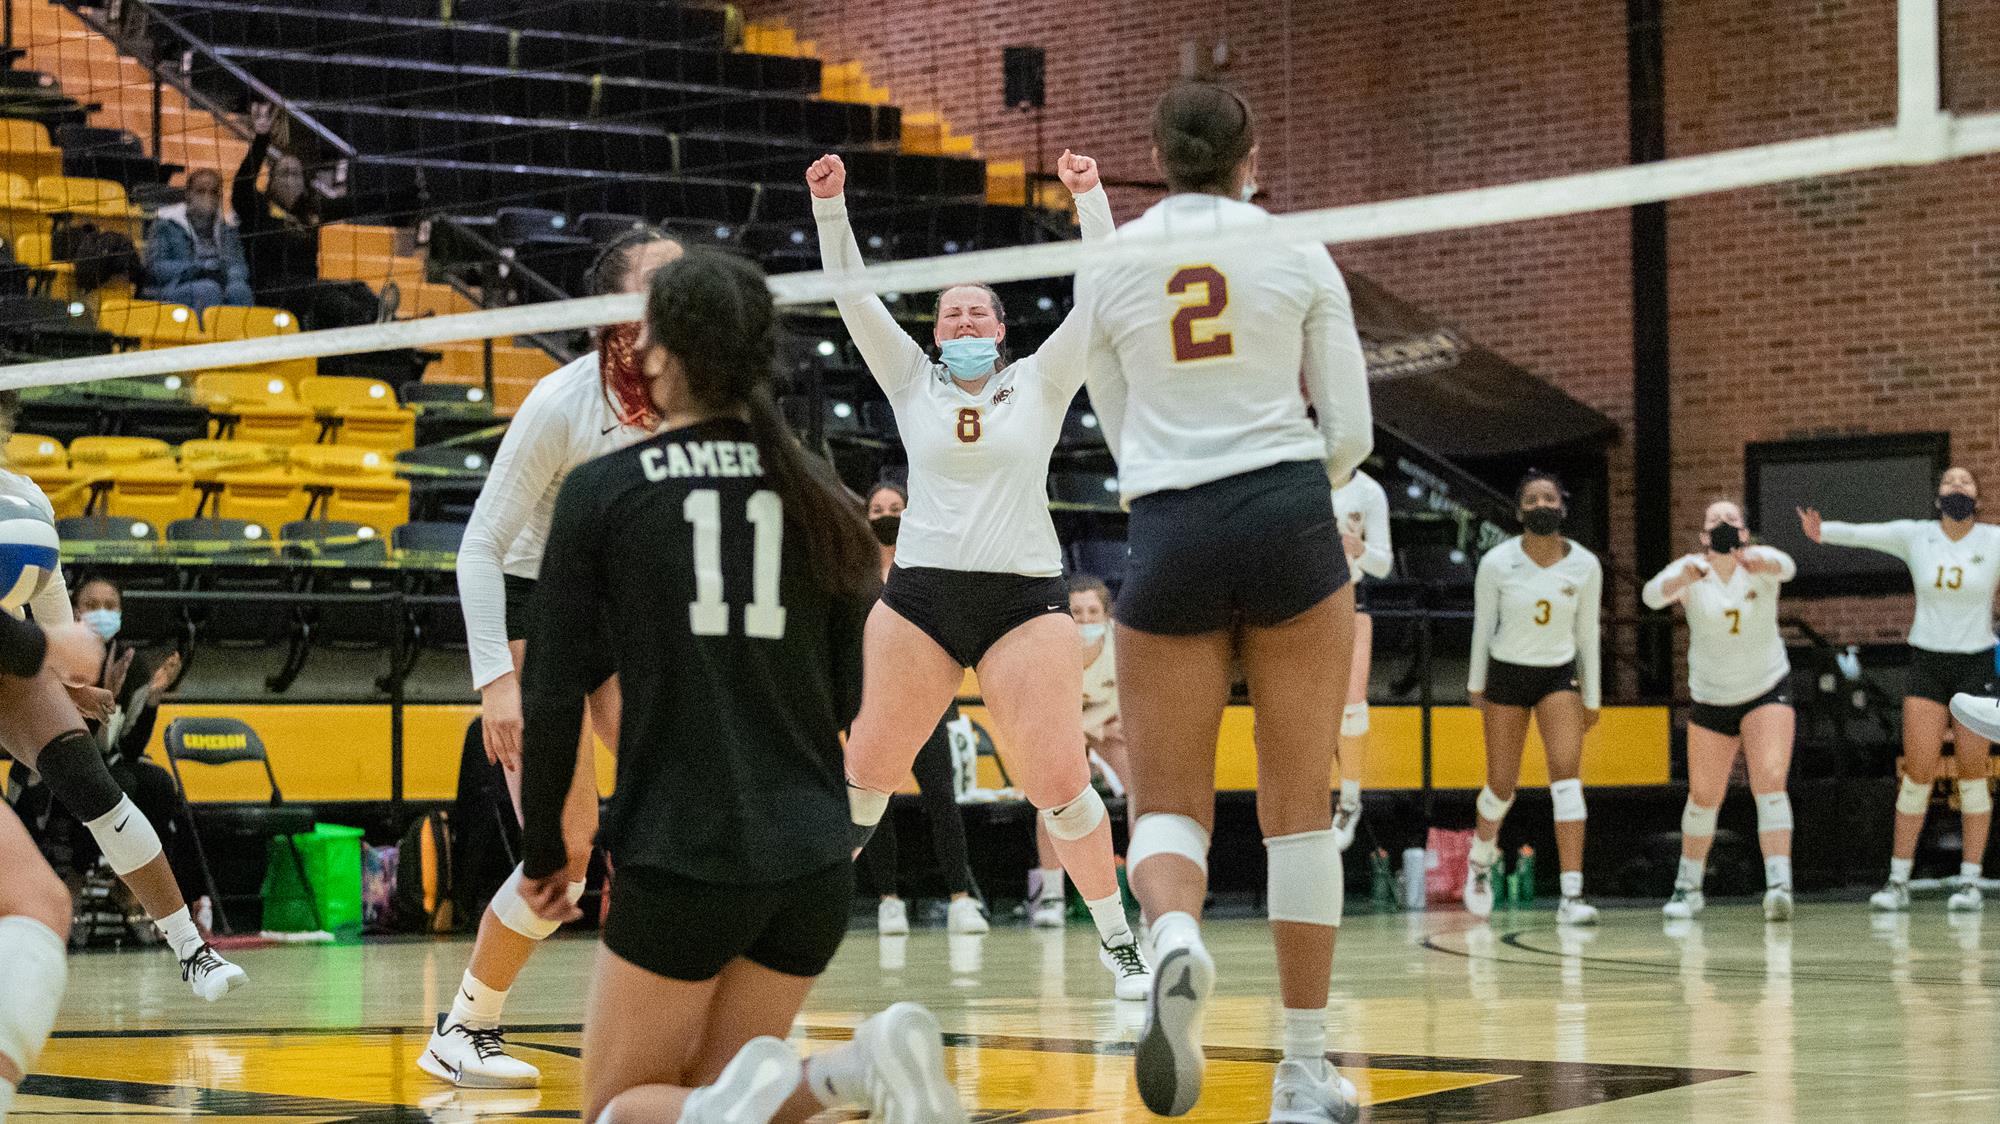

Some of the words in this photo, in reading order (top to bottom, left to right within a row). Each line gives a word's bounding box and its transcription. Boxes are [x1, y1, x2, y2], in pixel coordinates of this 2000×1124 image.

[1166, 263, 1235, 363] 2
[956, 407, 982, 444] 8
[639, 440, 765, 482] CAMER
[683, 488, 787, 640] 11
[1934, 565, 1963, 590] 13
[1534, 599, 1552, 626] 3
[1723, 609, 1741, 636] 7
